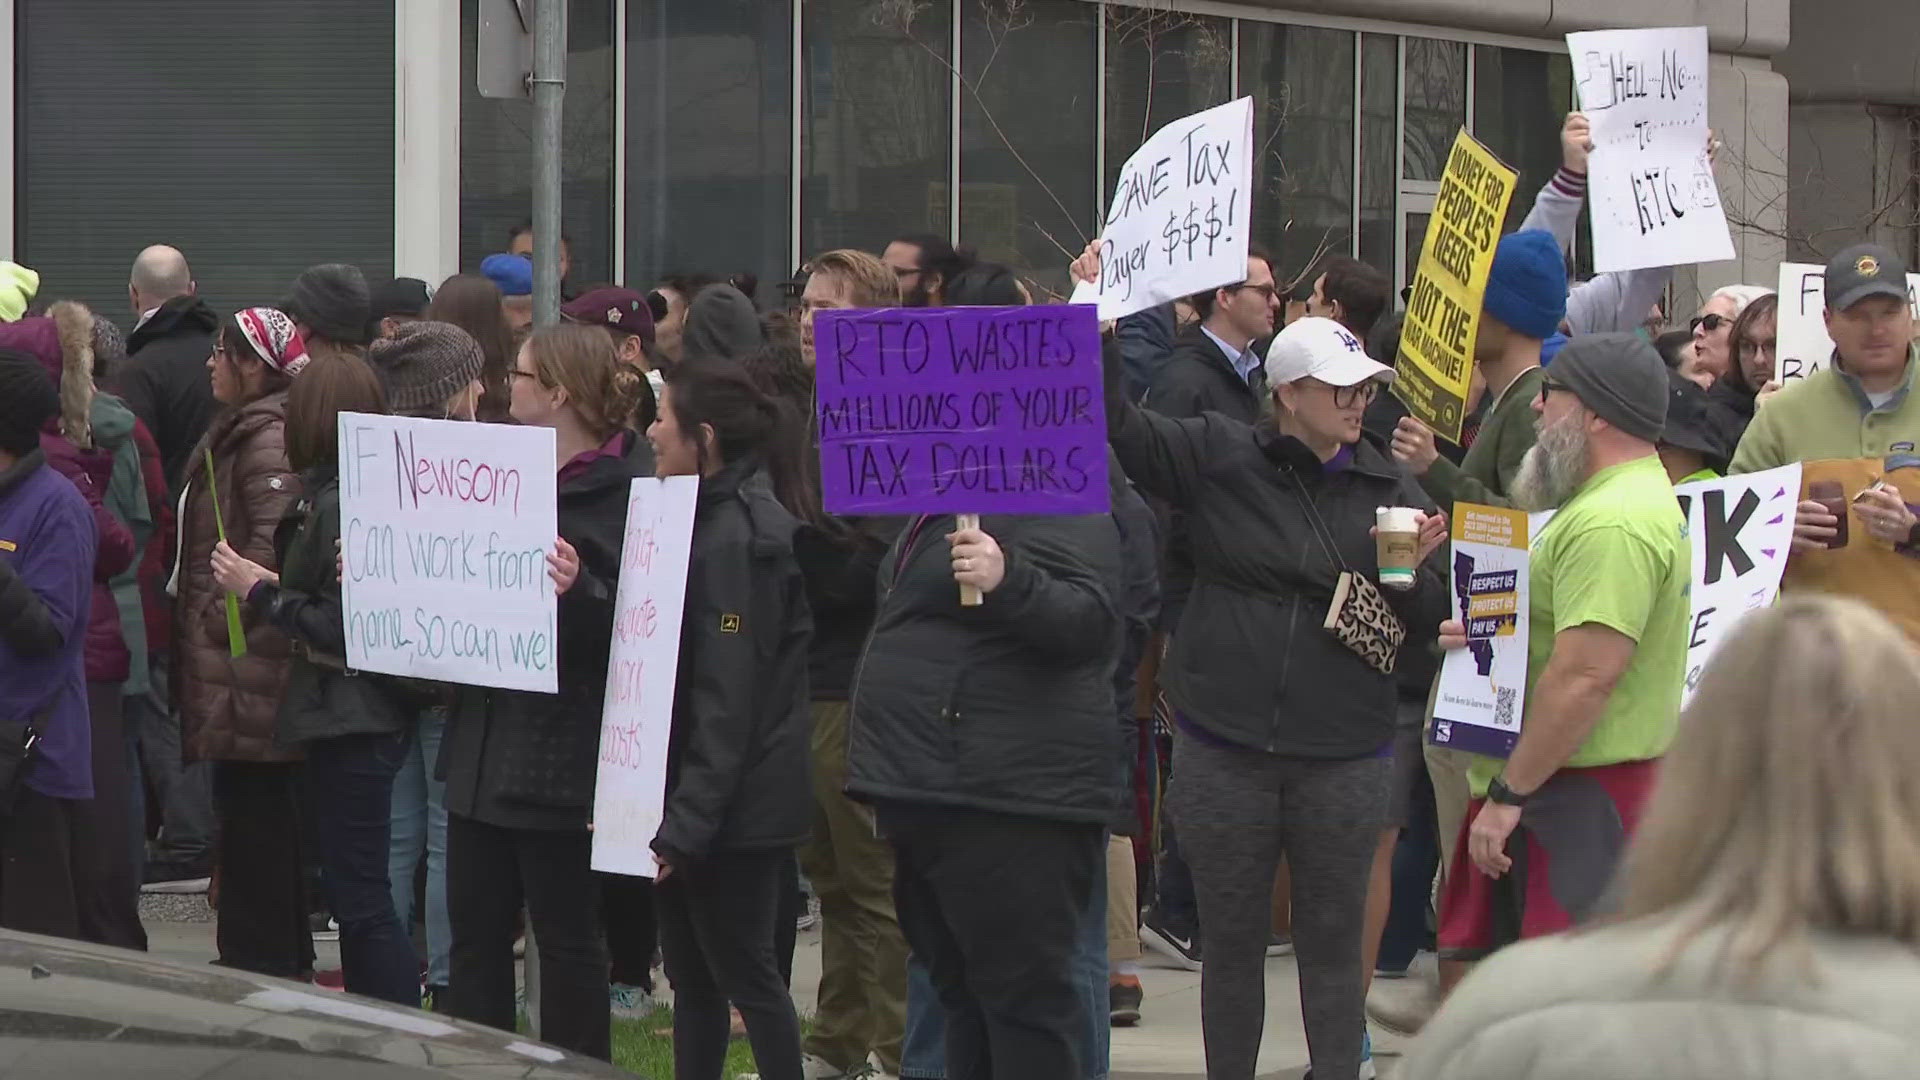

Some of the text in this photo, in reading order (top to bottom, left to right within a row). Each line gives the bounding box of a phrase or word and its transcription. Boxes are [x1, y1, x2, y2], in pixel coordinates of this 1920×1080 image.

[1609, 50, 1647, 106] HELL
[1449, 142, 1505, 213] MONEY FOR
[1437, 176, 1495, 253] PEOPLE'S
[1099, 239, 1150, 302] Payer
[1433, 222, 1475, 288] NEEDS
[1411, 273, 1471, 356] NOT THE
[834, 316, 1077, 386] RTO WASTES
[821, 385, 1095, 438] MILLIONS OF YOUR
[342, 424, 521, 519] IF Newsom
[840, 441, 1089, 497] TAX DOLLARS
[484, 531, 545, 602] from
[1471, 574, 1515, 592] RESPECT US
[1471, 597, 1515, 612] PROTECT US
[1471, 619, 1497, 636] PAY US
